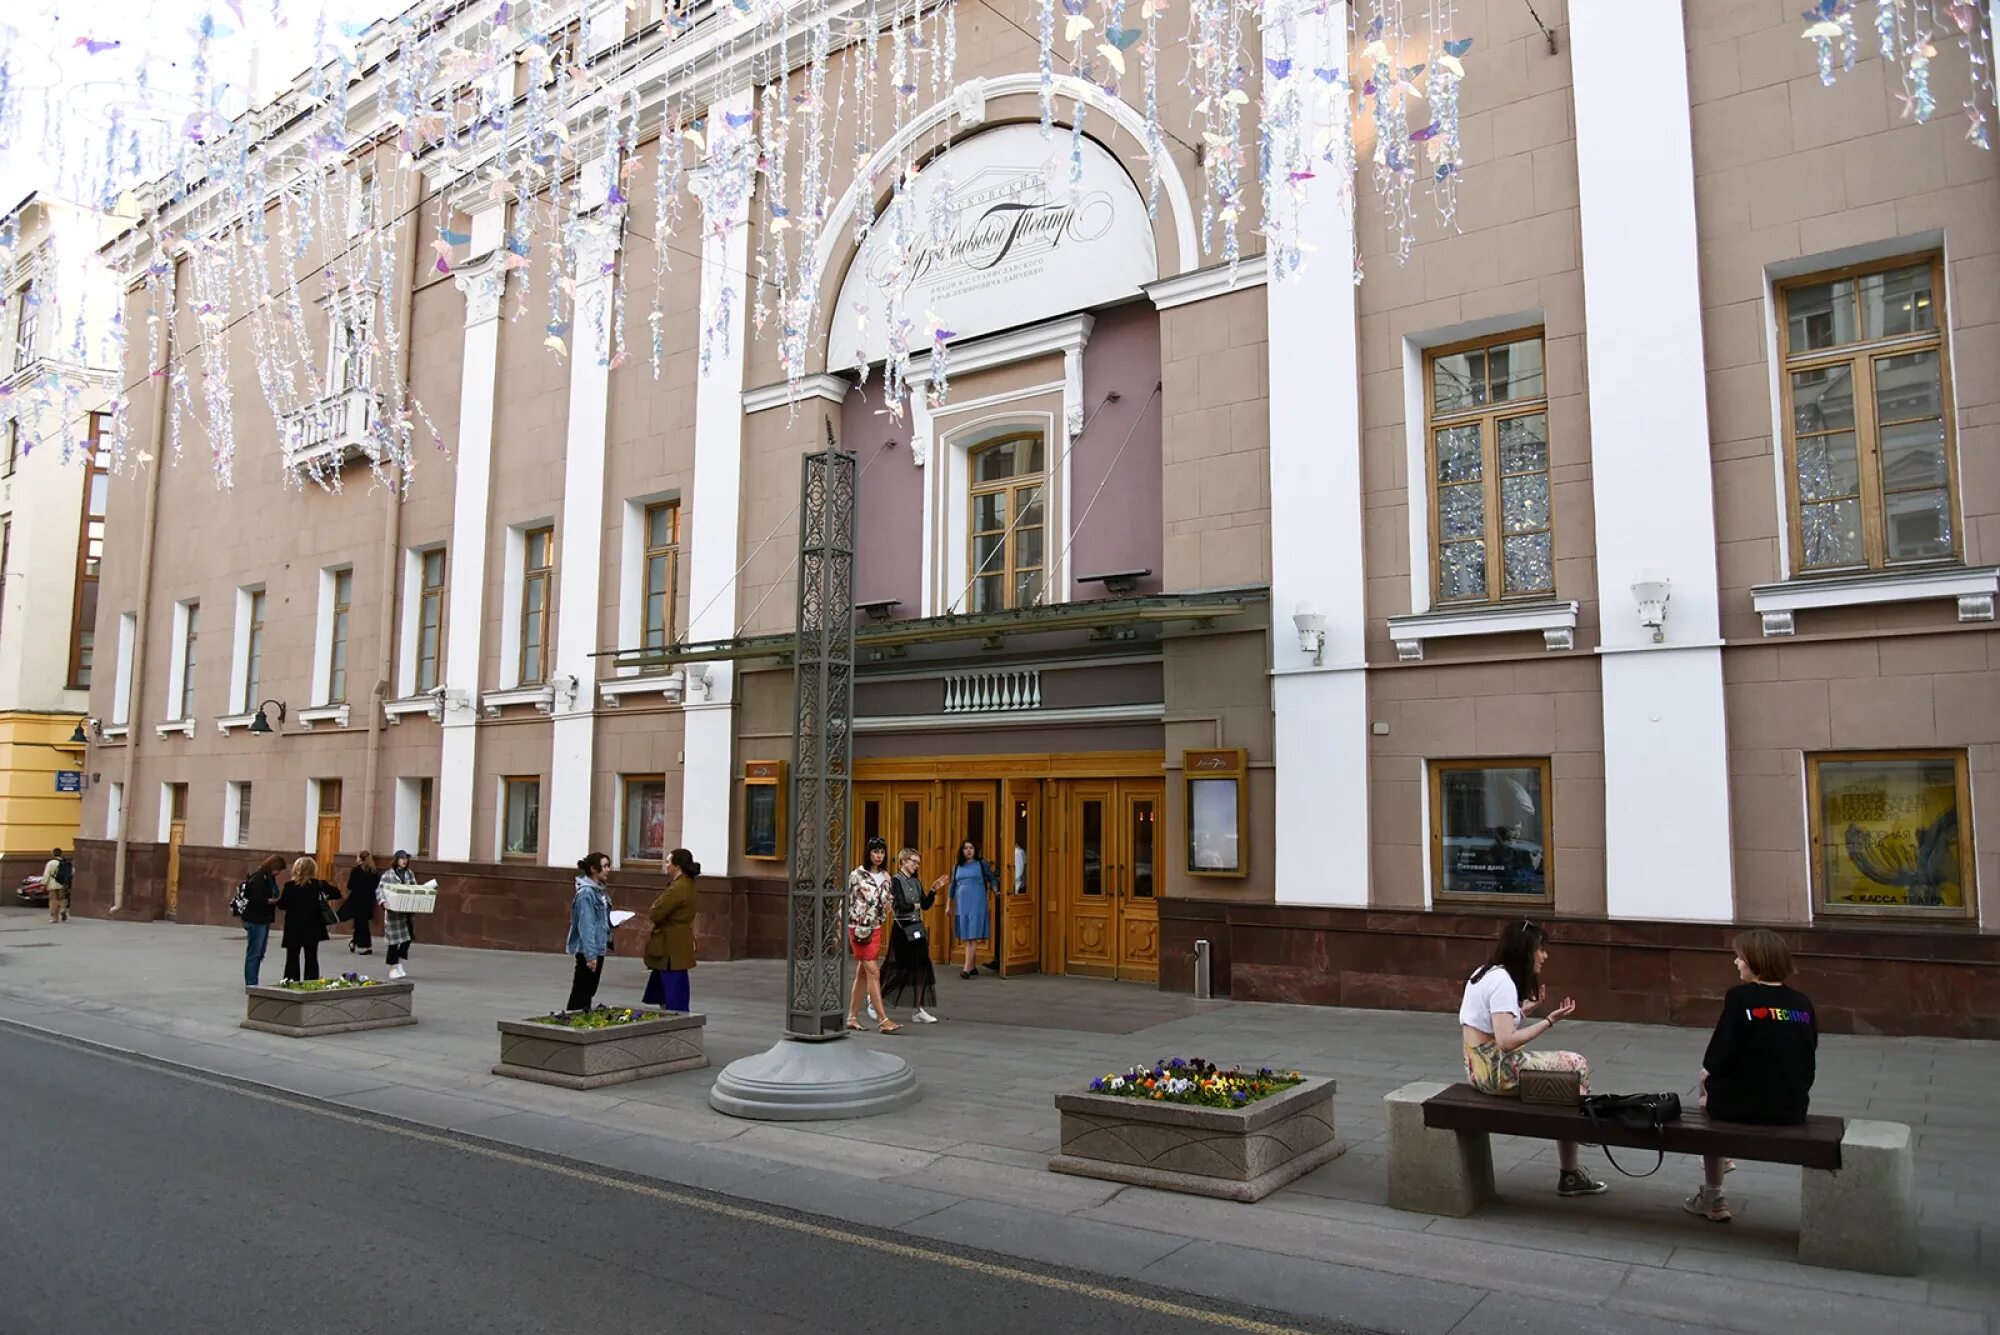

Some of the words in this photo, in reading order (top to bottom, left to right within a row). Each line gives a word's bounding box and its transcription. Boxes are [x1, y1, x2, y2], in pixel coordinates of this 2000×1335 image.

[946, 174, 1041, 212] ОСКОВСКИЙ
[1860, 894, 1897, 903] КАССА
[1746, 1009, 1752, 1021] I
[1769, 1008, 1810, 1024] TECHNO
